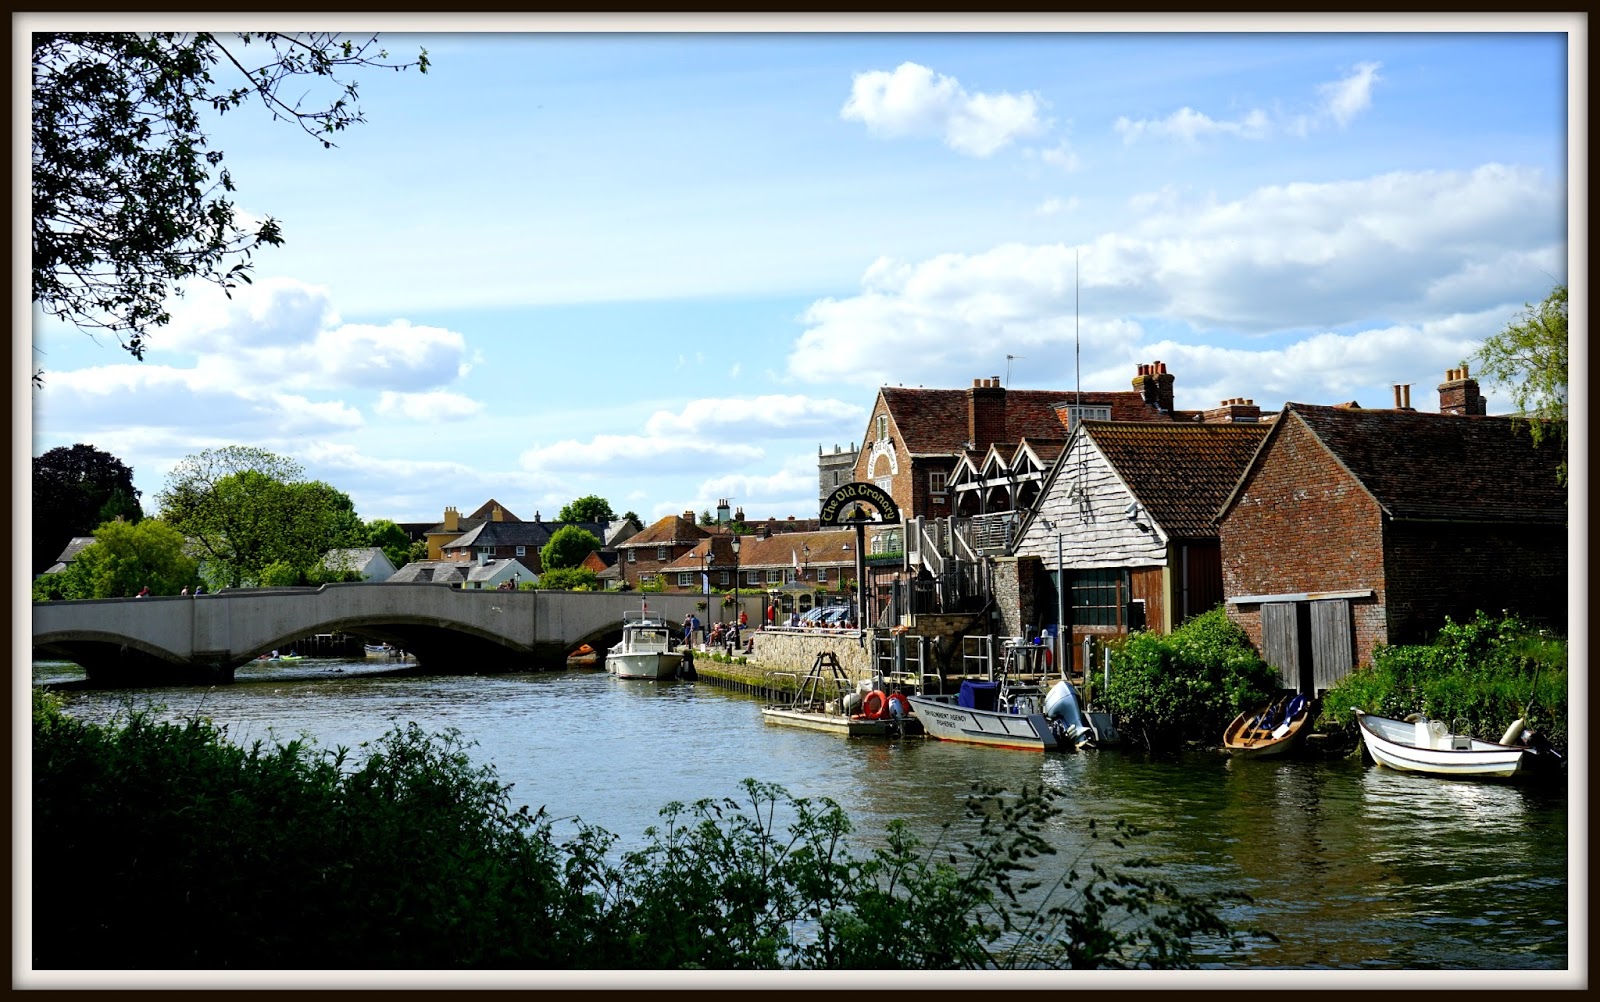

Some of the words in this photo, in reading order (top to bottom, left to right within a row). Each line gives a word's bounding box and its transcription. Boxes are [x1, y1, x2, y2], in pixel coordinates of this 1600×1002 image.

[821, 500, 838, 521] The
[835, 485, 857, 501] Old
[857, 484, 895, 520] Granary
